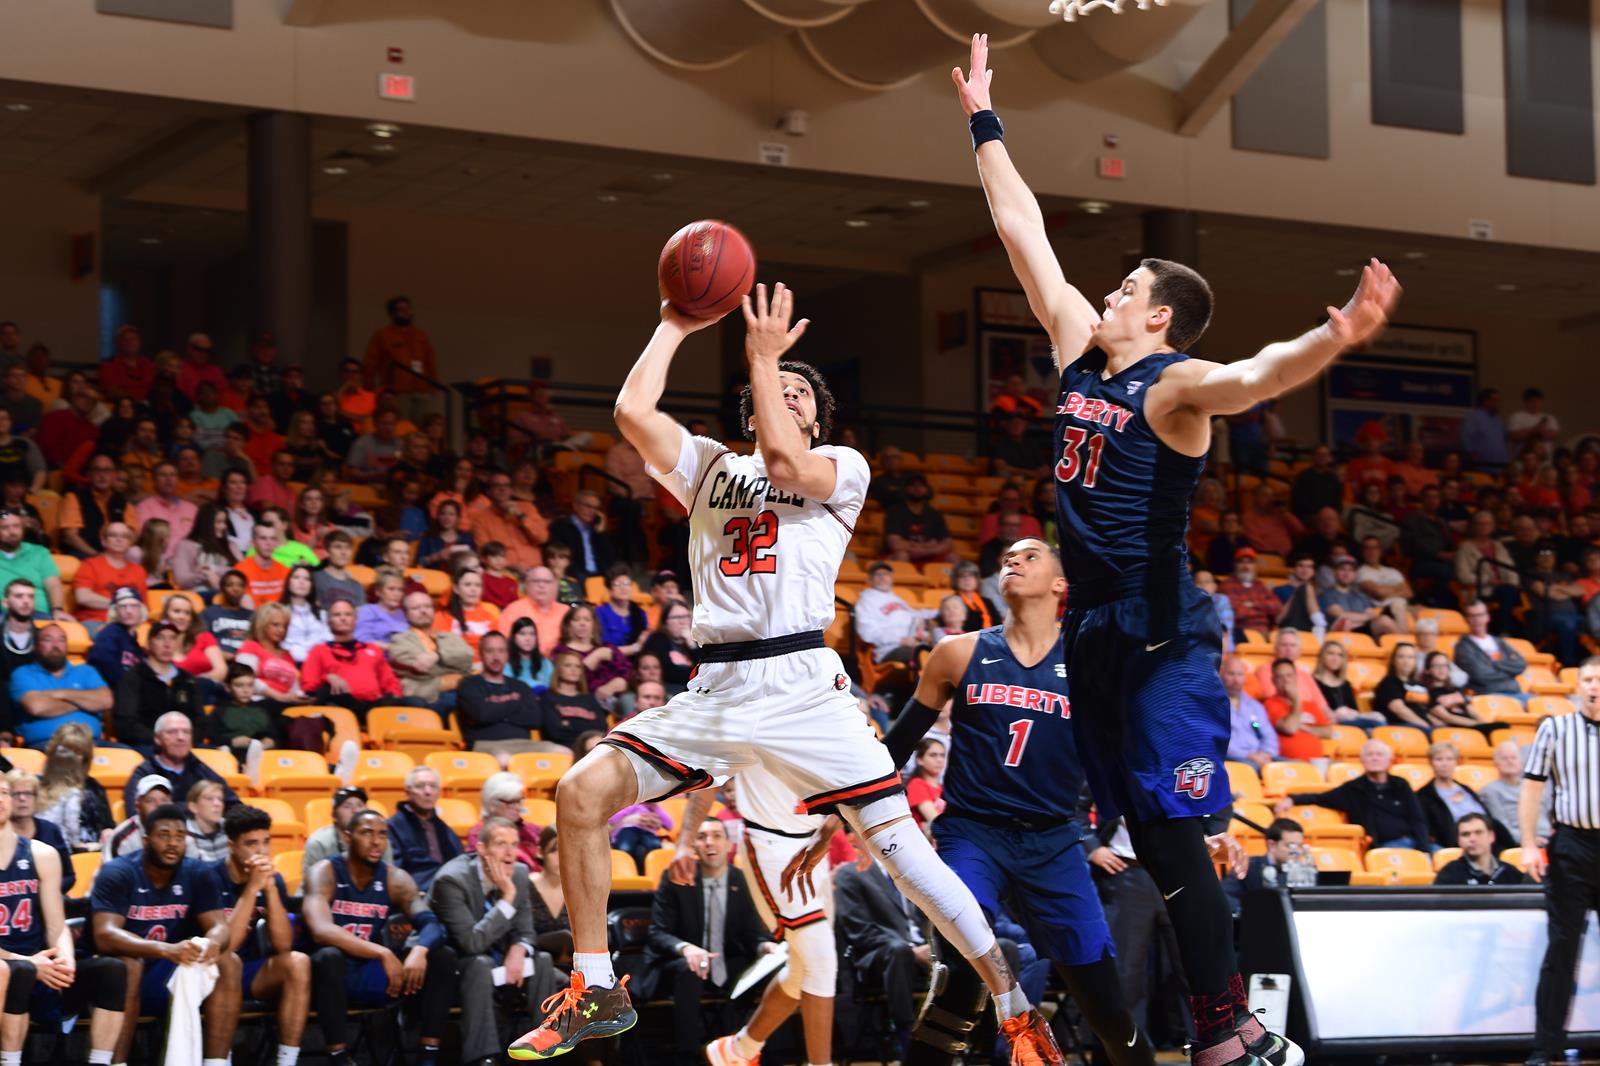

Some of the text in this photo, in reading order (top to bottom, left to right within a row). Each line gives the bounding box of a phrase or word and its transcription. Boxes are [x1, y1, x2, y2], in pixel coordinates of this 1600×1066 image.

[1056, 391, 1135, 433] BERTY
[1055, 425, 1105, 488] 31
[719, 509, 779, 577] 32
[966, 683, 1071, 719] LIBERTY
[1004, 718, 1034, 767] 1
[127, 903, 189, 921] LIBERTY
[331, 899, 389, 919] LIBERTY
